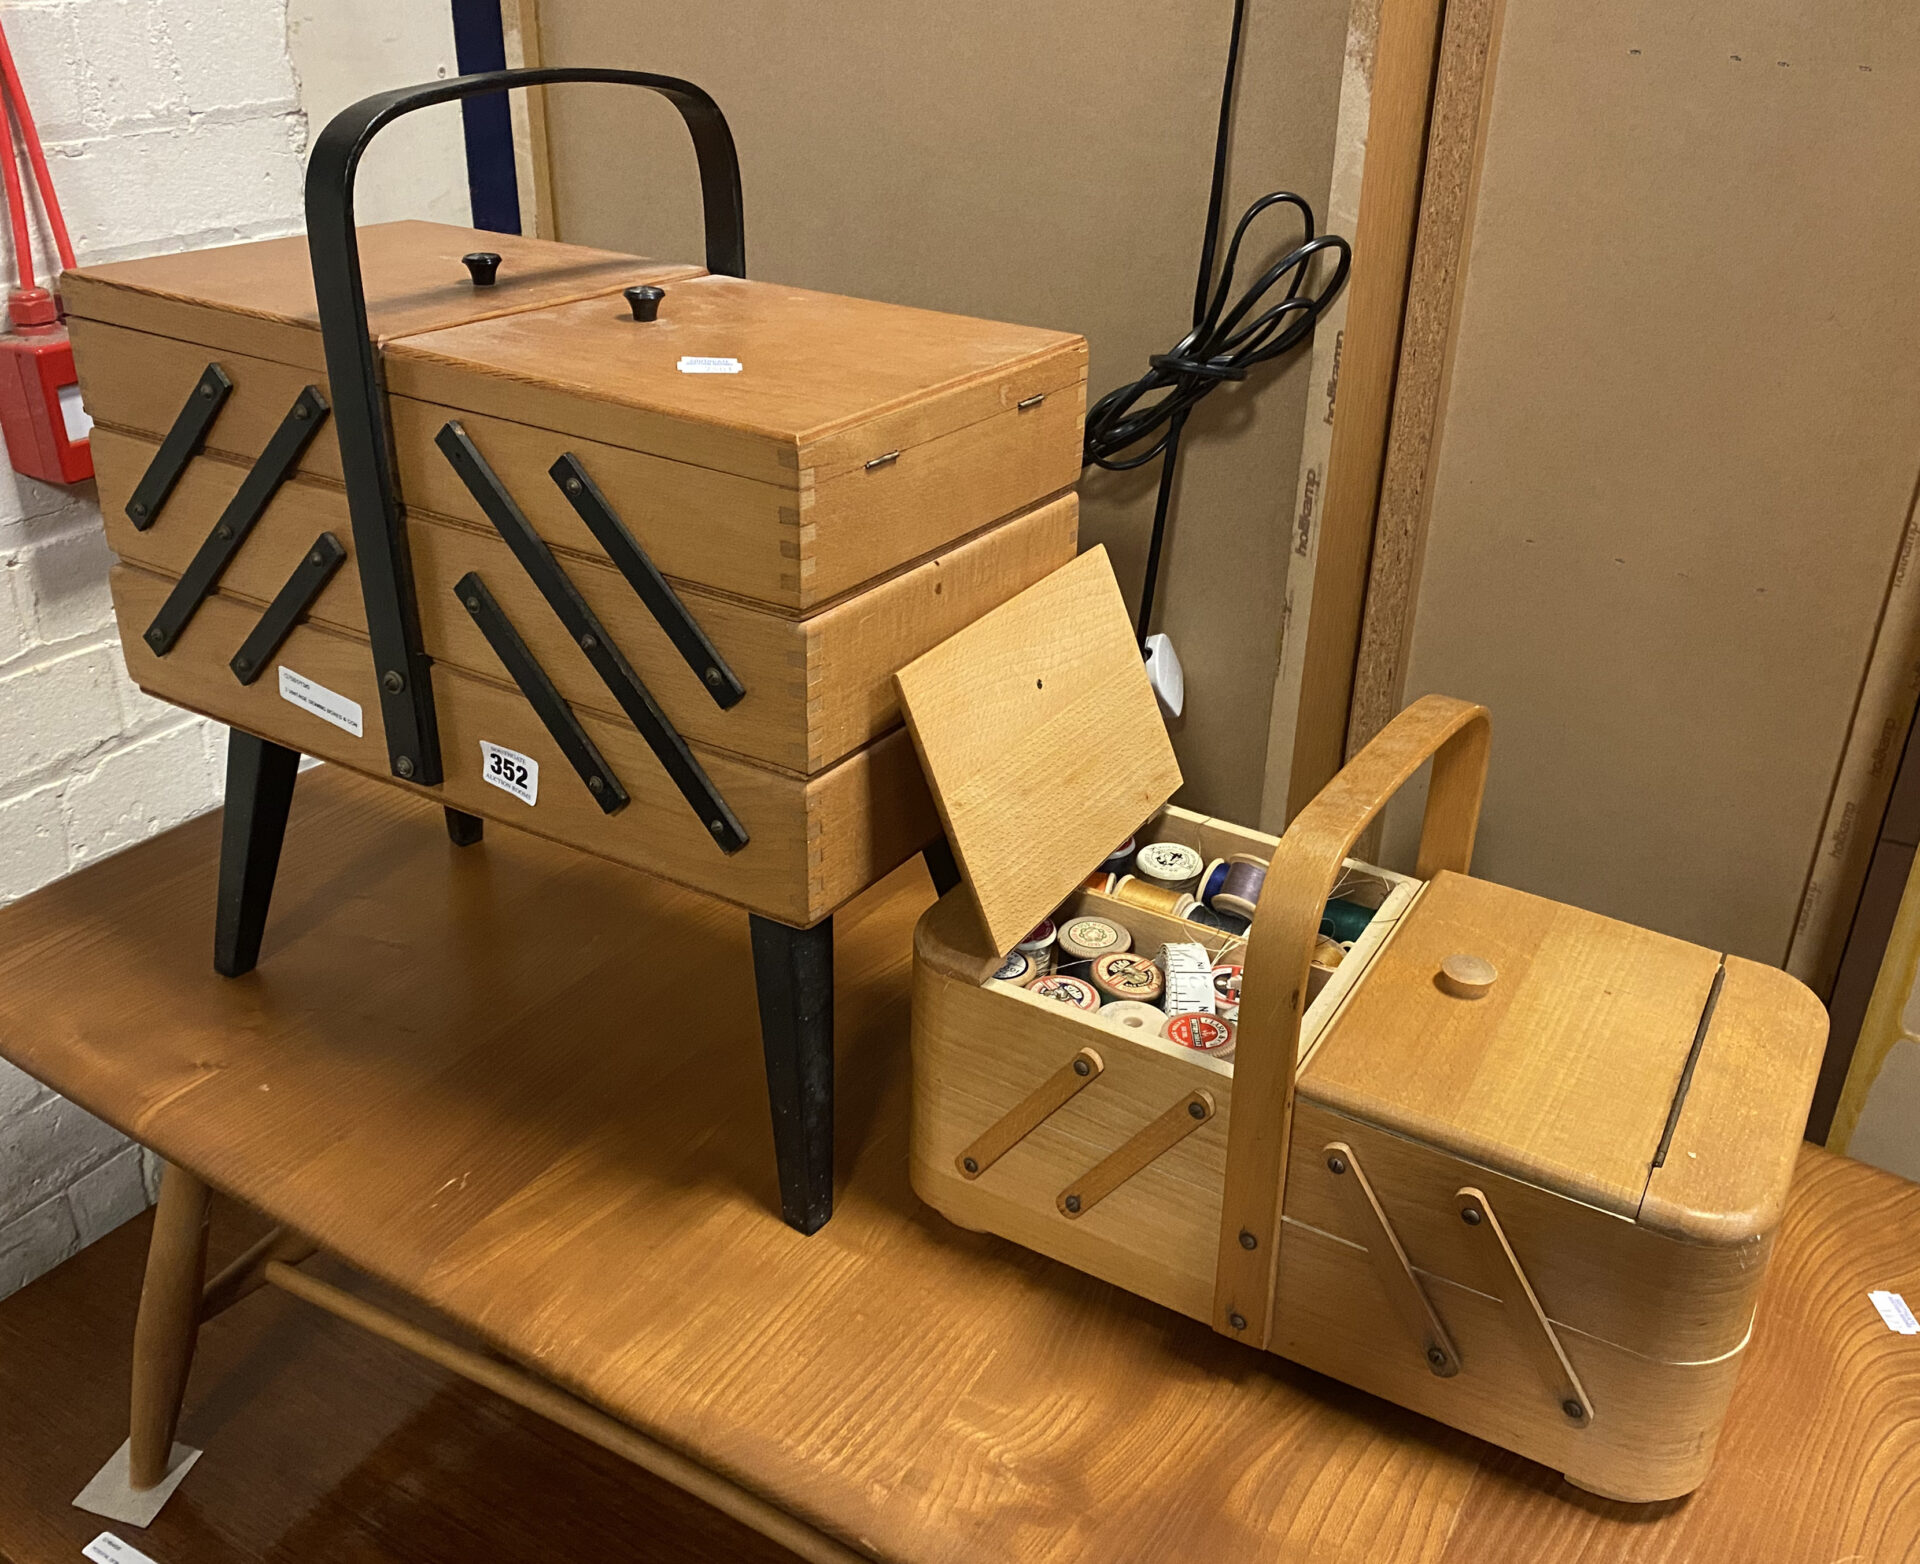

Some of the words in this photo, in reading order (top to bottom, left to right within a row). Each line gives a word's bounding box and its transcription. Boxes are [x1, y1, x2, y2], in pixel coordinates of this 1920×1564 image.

[486, 773, 511, 789] AUCTION
[511, 785, 531, 800] ROOMS
[490, 753, 528, 789] 352
